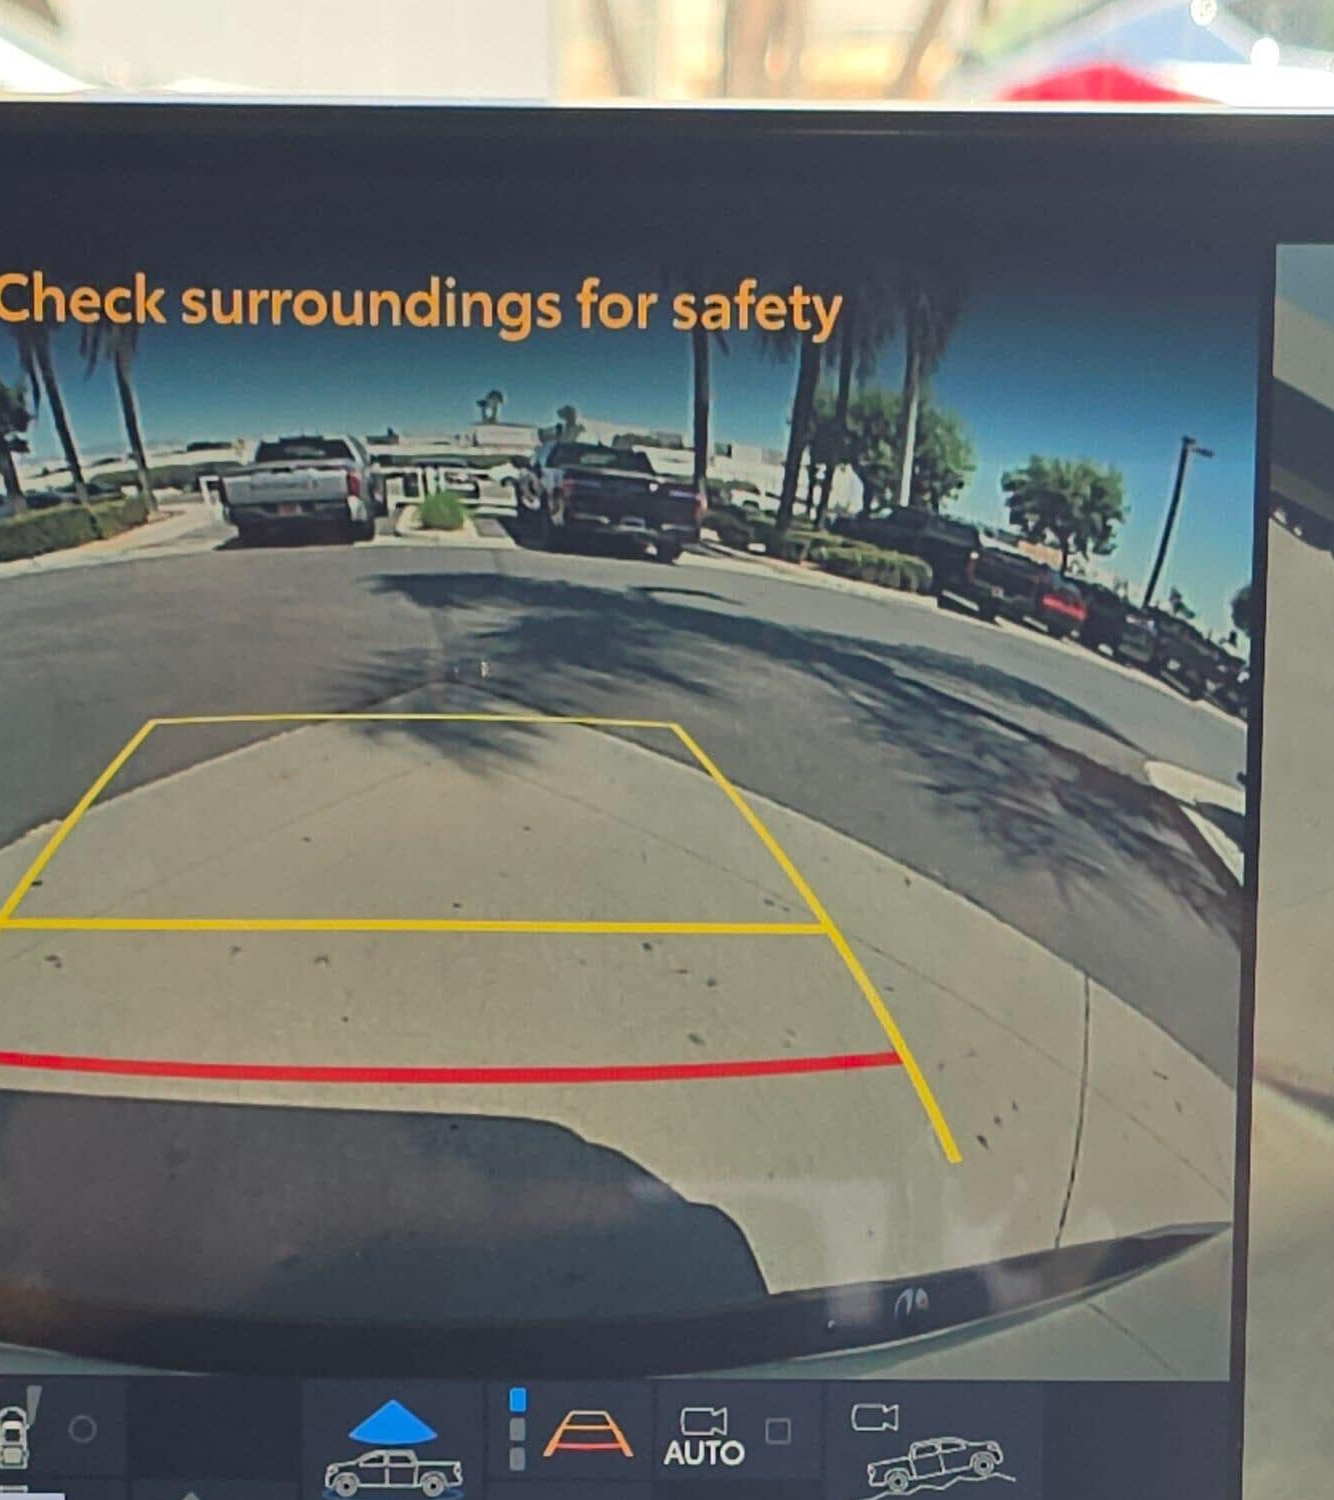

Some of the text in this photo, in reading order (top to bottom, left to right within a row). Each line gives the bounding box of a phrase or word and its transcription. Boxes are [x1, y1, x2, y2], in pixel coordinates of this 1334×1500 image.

[181, 276, 561, 341] surroundings
[578, 277, 657, 330] for
[672, 278, 843, 343] safety
[664, 1440, 745, 1466] AUTO
